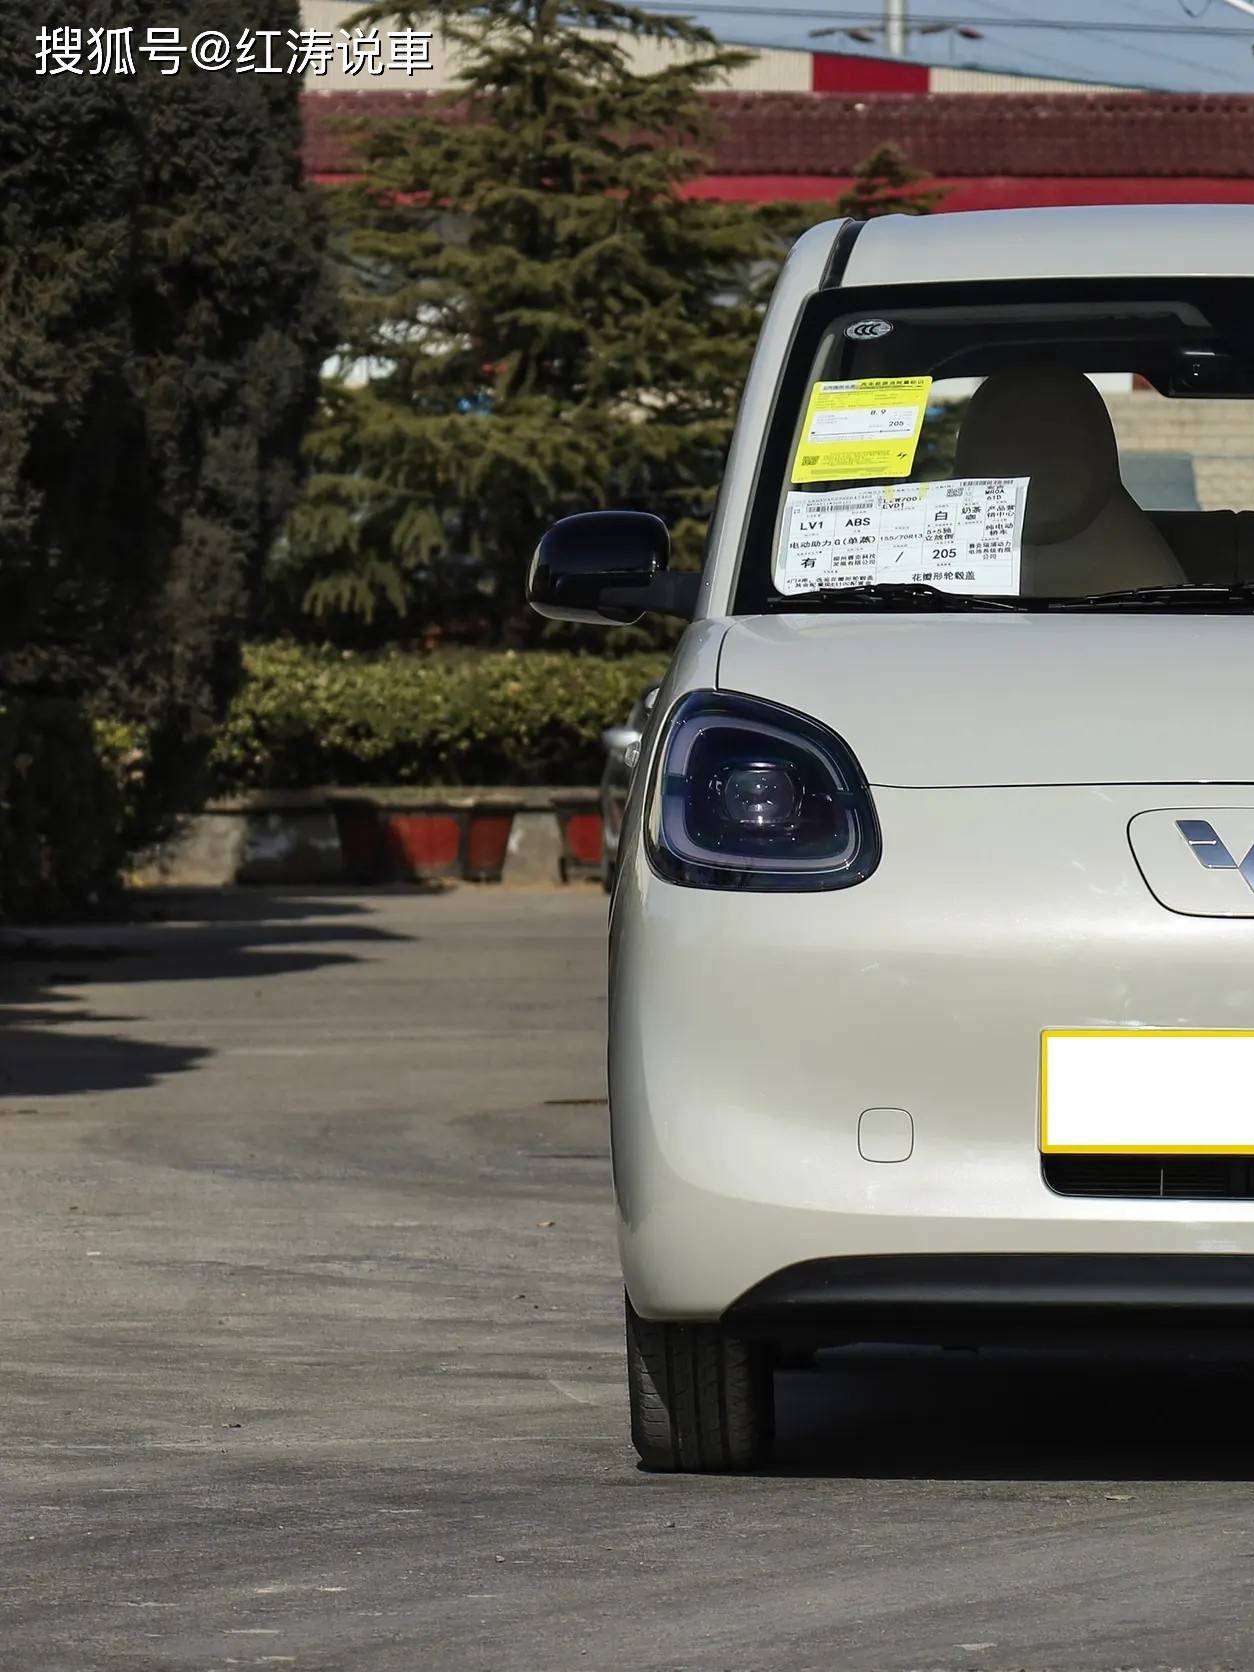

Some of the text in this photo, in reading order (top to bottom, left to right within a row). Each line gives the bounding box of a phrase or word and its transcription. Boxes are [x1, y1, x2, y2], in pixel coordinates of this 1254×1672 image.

[934, 510, 948, 522] 白
[800, 521, 824, 531] LV1
[845, 517, 871, 527] ABS
[790, 540, 832, 549] 电动助力
[932, 548, 957, 560] 205
[800, 557, 817, 569] 有
